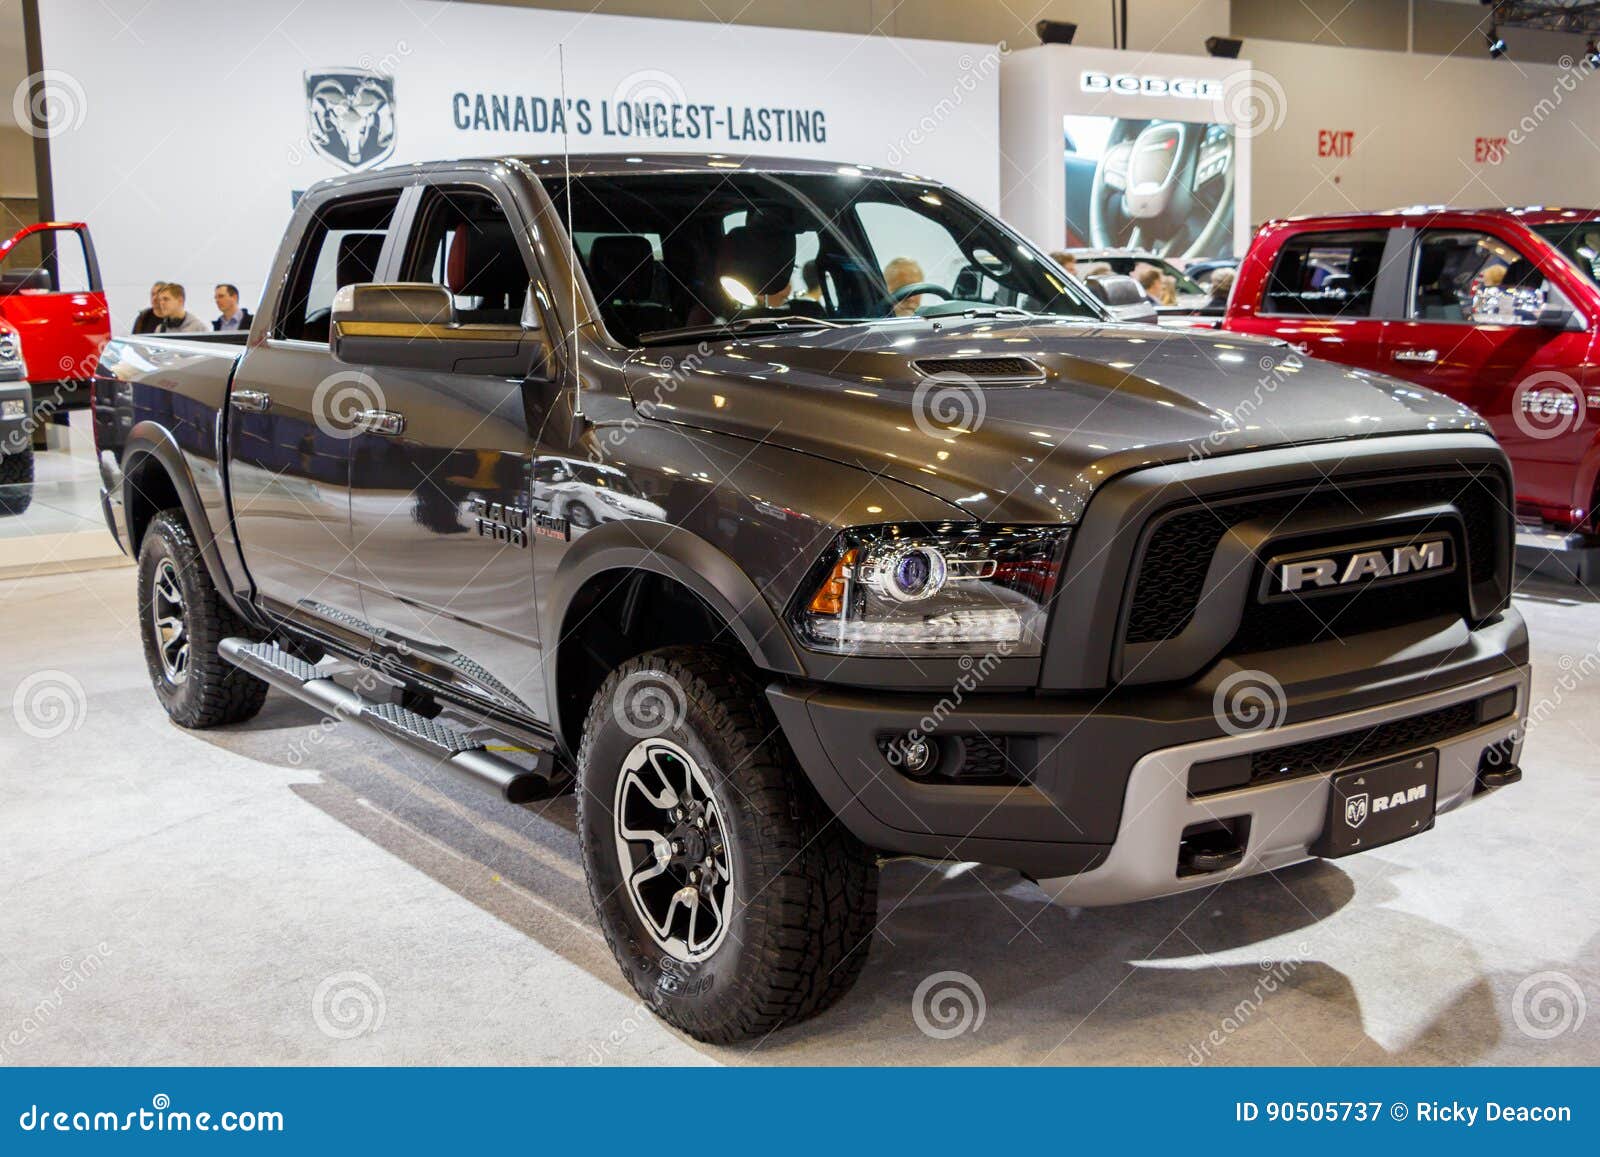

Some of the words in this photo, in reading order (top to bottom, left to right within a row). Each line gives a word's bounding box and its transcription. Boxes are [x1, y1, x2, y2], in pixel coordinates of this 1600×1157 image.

[1082, 72, 1223, 100] DODGE
[452, 92, 592, 135] CANADA'S
[601, 100, 827, 143] LONGEST-LASTING
[1318, 129, 1354, 157] EXIT
[473, 498, 527, 528] RAM
[1281, 541, 1444, 593] RAM
[1372, 784, 1428, 813] RAM
